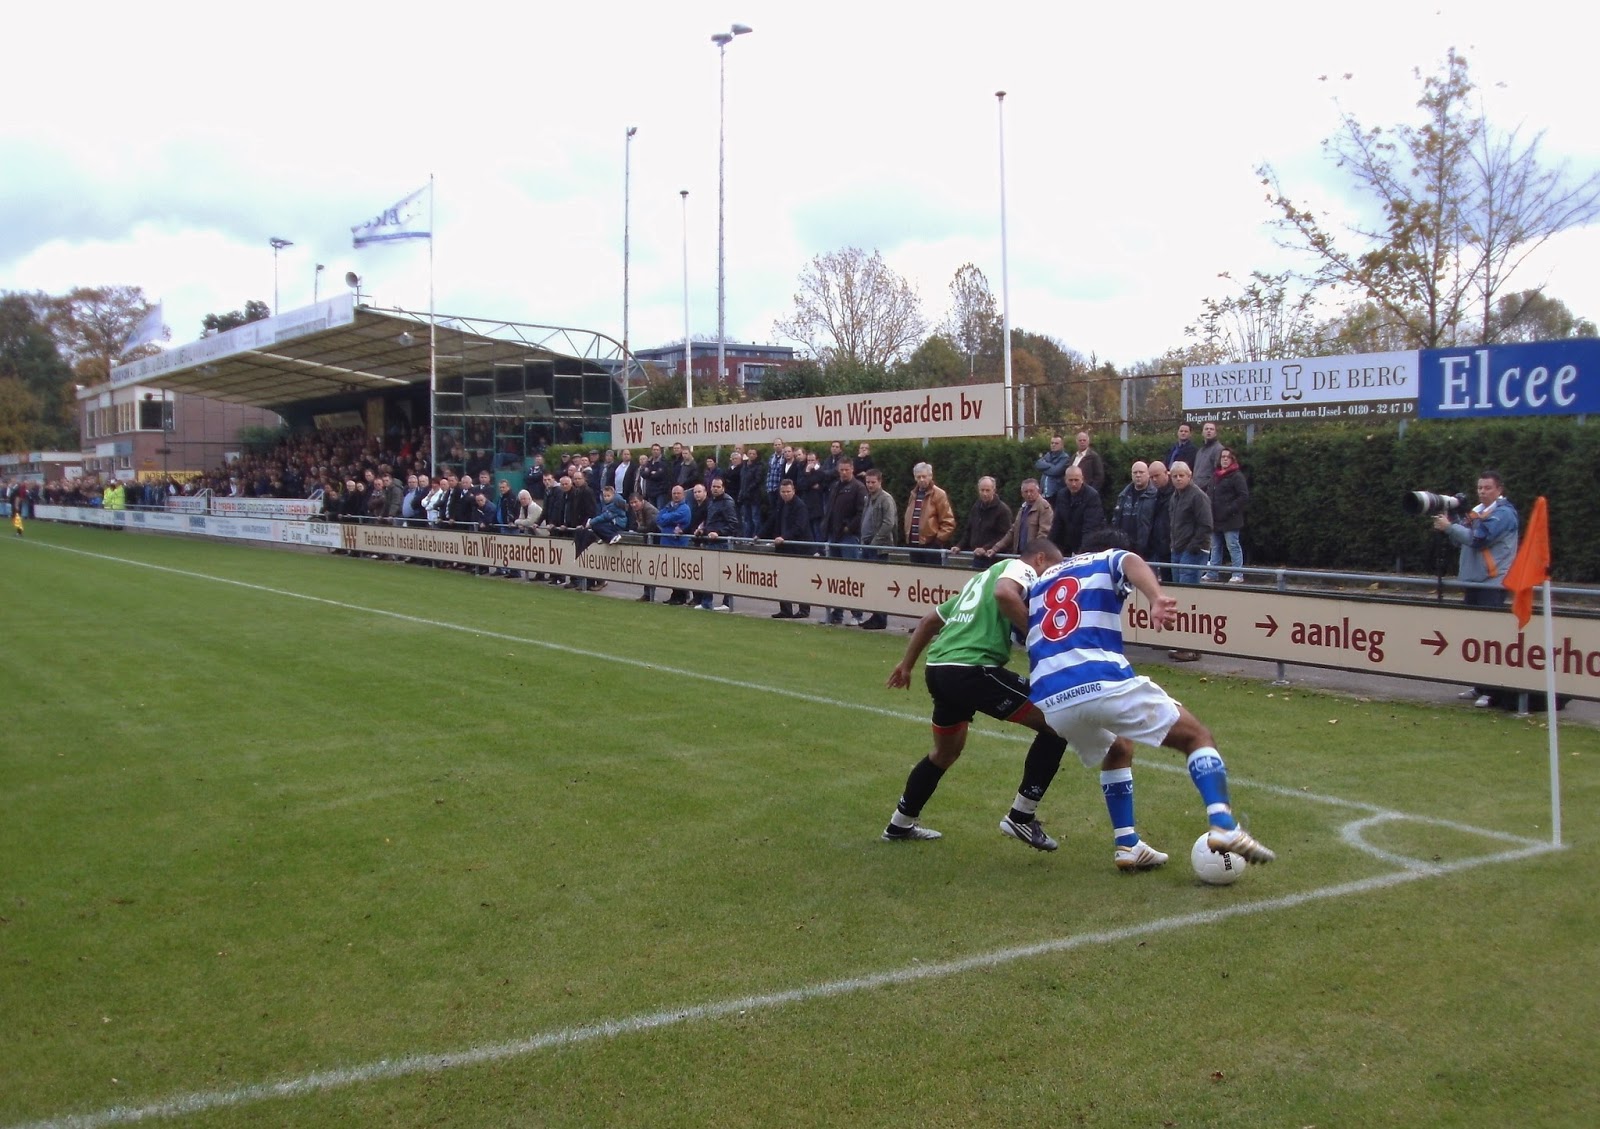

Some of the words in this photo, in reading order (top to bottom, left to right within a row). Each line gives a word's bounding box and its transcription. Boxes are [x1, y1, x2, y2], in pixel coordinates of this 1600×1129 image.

[1191, 368, 1273, 388] BRASSERIJ
[1312, 369, 1341, 391] DE
[1347, 365, 1407, 389] BERG
[1438, 349, 1577, 411] Elcee
[1204, 386, 1273, 404] EETCAFE
[651, 417, 698, 436] Technisch
[704, 413, 803, 434] Installatiebureau
[815, 403, 842, 428] Van
[847, 395, 953, 432] Wijngaarden
[961, 393, 983, 420] bv
[1186, 411, 1220, 424] Reigerhof
[1222, 411, 1231, 421] 27
[1238, 408, 1283, 420] Nieuwerkerk
[1302, 407, 1316, 417] den
[1318, 406, 1340, 418] IJssel
[1348, 405, 1369, 415] 0180
[1403, 402, 1413, 413] 19
[364, 531, 395, 548] Technisch
[397, 533, 459, 555] Installatiebureau
[461, 535, 479, 557] Van
[481, 536, 545, 567] Wijngaarden
[549, 540, 563, 566] bv
[578, 551, 643, 576] Nieuwerkerk
[648, 555, 668, 578] a/d
[672, 556, 704, 581] IJssel
[736, 563, 778, 589] klimaat
[827, 578, 866, 599] water
[1040, 576, 1081, 641] 8
[1128, 602, 1228, 645] tening
[1291, 617, 1386, 663] aanleg
[1056, 682, 1102, 704] SPAKENBURG
